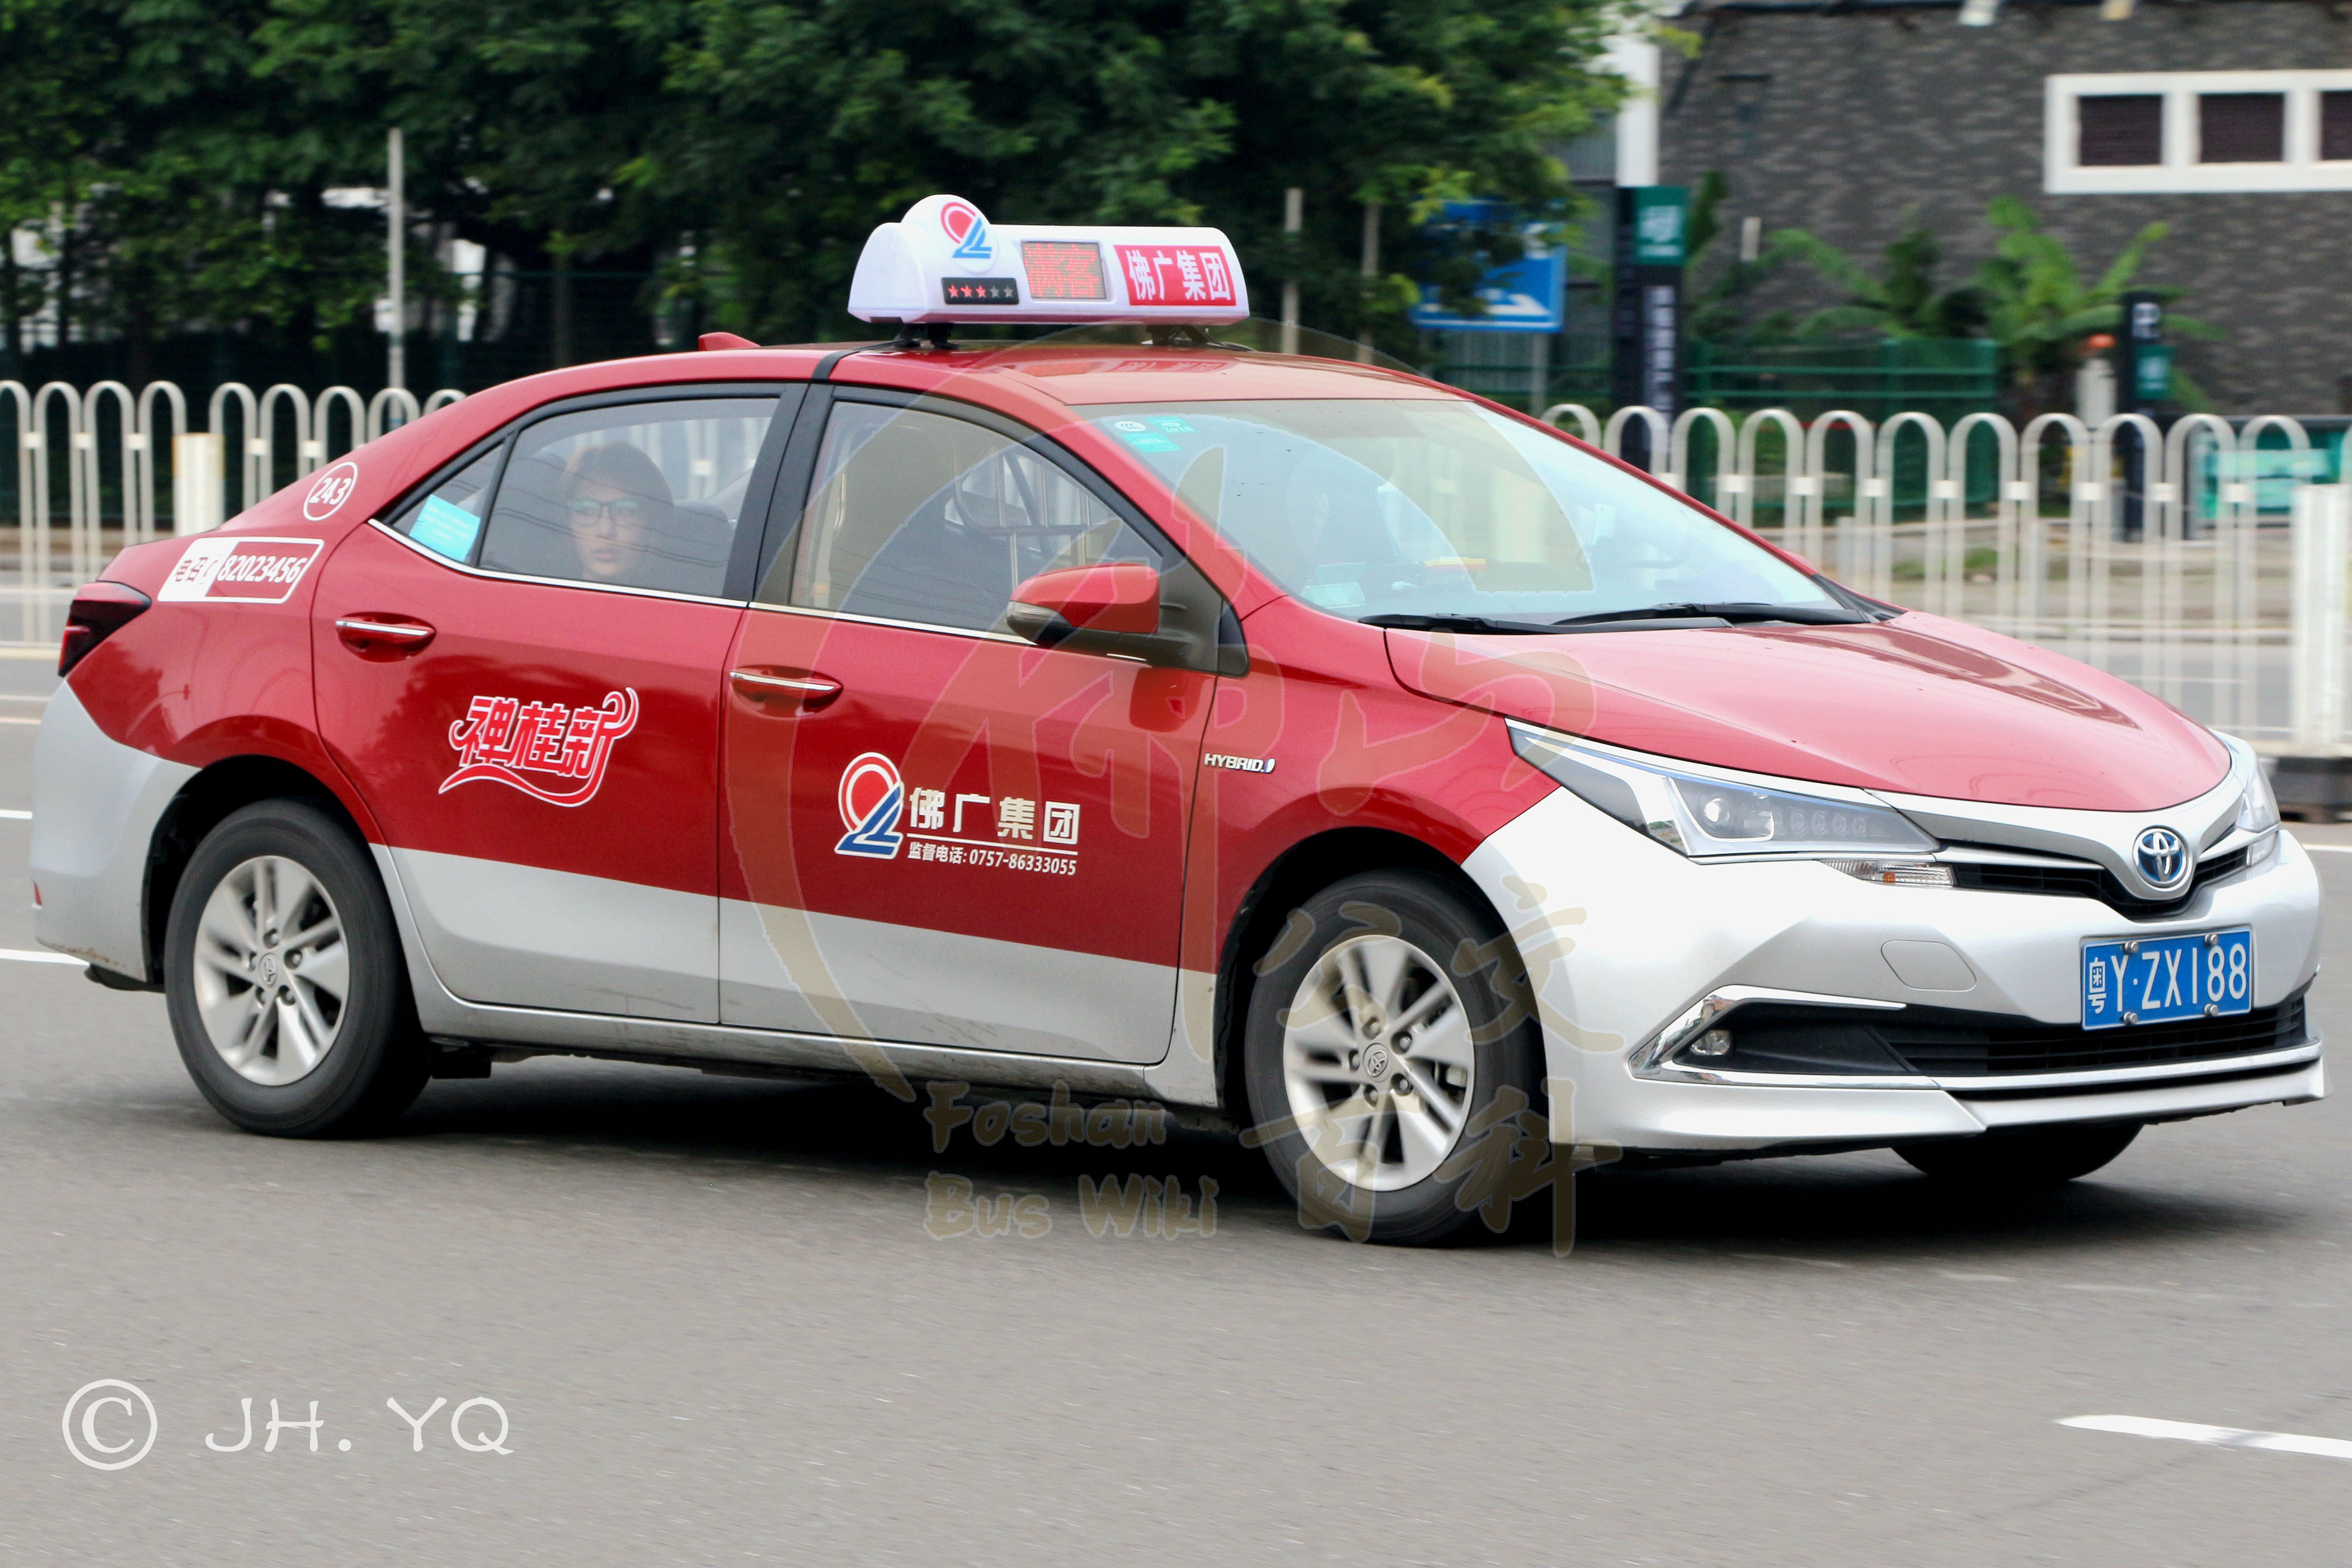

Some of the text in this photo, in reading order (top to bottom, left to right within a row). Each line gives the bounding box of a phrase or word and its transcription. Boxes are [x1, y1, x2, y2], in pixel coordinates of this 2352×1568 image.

[1128, 249, 1231, 301] 佛广集团
[309, 477, 352, 505] 243
[217, 554, 308, 583] 82023456
[909, 787, 1080, 845] 佛广集团
